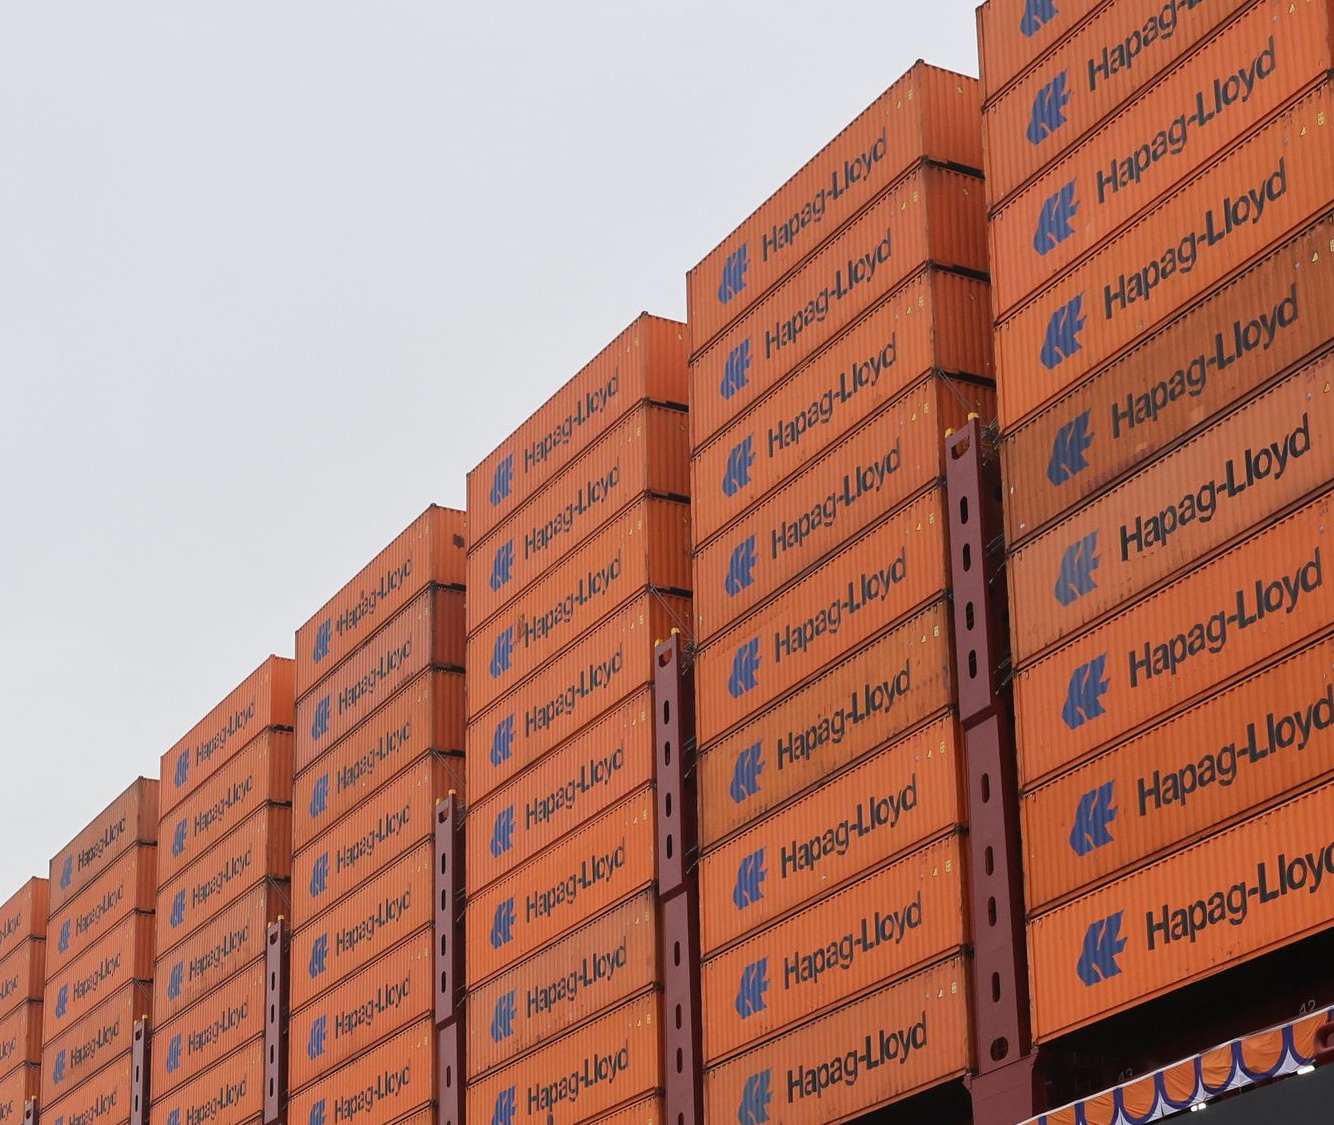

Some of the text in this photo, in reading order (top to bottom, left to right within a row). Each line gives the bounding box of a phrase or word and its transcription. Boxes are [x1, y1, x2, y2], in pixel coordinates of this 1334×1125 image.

[1097, 36, 1276, 203] Hapag-Lloyd
[763, 127, 886, 262] Hapag-Lloyd
[1104, 159, 1287, 319] Hapag-Lloyd
[766, 229, 891, 358] Hapag-Lloyd
[768, 334, 896, 457] Hapag-Lloyd
[1111, 283, 1299, 438] Hapag-Lloyd
[525, 368, 619, 473] Hapag-Lloyd
[525, 457, 620, 559] Hapag-Lloyd
[772, 440, 901, 559] Hapag-Lloyd
[1120, 413, 1311, 561] Hapag-Lloyd
[525, 549, 621, 646] Hapag-Lloyd
[775, 549, 906, 662] Hapag-Lloyd
[1130, 550, 1323, 687] Hapag-Lloyd
[526, 643, 622, 737] Hapag-Lloyd
[778, 660, 911, 769] Hapag-Lloyd
[526, 741, 624, 830] Hapag-Lloyd
[1138, 686, 1334, 816] Hapag-Lloyd
[527, 837, 625, 922] Hapag-Lloyd
[781, 774, 917, 878] Hapag-Lloyd
[527, 936, 626, 1018] Hapag-Lloyd
[785, 894, 922, 989] Hapag-Lloyd
[528, 1039, 629, 1115] Hapag-Lloyd
[787, 1012, 927, 1102] Hapag-Lloyd
